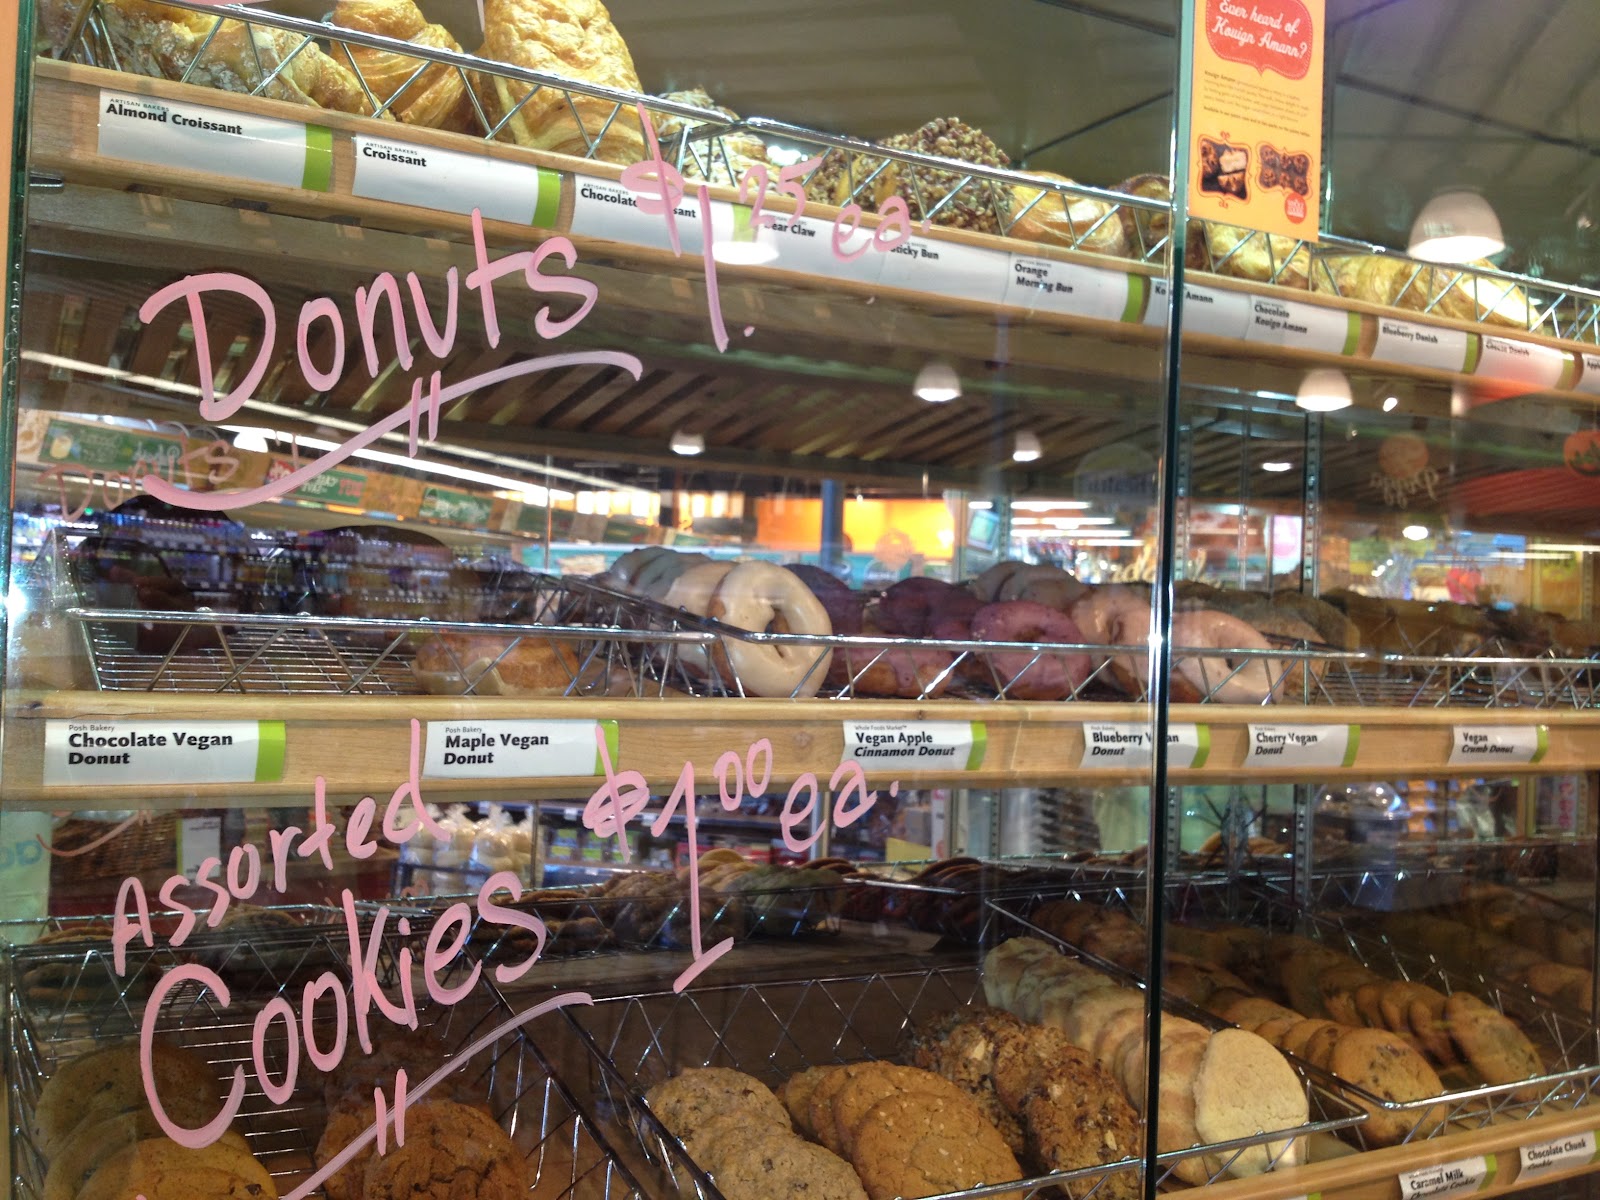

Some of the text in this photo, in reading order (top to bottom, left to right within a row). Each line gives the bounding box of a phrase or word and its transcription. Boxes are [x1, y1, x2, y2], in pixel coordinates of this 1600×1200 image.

[1249, 5, 1284, 30] heard
[1284, 18, 1301, 38] of
[109, 97, 170, 112] ARTISAN BAKERS
[106, 104, 243, 135] Almond Croissant
[365, 142, 393, 151] ARTISAN
[362, 146, 427, 167] Croissant
[764, 220, 789, 232] ear
[790, 224, 816, 237] Claw
[921, 248, 939, 260] Bun
[1015, 263, 1048, 278] Orange
[1056, 282, 1073, 294] Bun
[139, 207, 599, 422] Donuts
[1254, 303, 1290, 318] Chocolate
[1382, 325, 1414, 341] Blueberry
[1415, 332, 1438, 344] Danish
[90, 725, 115, 733] Bakery
[462, 726, 482, 734] Bakery
[68, 732, 233, 750] Chocolate Vegan
[445, 733, 549, 751] Maple Vegan
[855, 731, 933, 747] Vegan Apple
[1092, 731, 1179, 746] Blueberry Van
[1256, 732, 1318, 746] Cherry Vegan
[1462, 732, 1488, 745] Vegan
[68, 752, 130, 765] Donut
[444, 752, 494, 765] Donut
[854, 746, 955, 757] Cinnamon Donut
[1091, 746, 1125, 756] Donut
[1255, 746, 1284, 756] Donut
[112, 718, 451, 976] Assorted
[138, 871, 548, 1149] Cookies
[1528, 1138, 1586, 1161] Chocolate Chunk
[1410, 1172, 1444, 1191] Caramel
[1445, 1168, 1464, 1182] Milk
